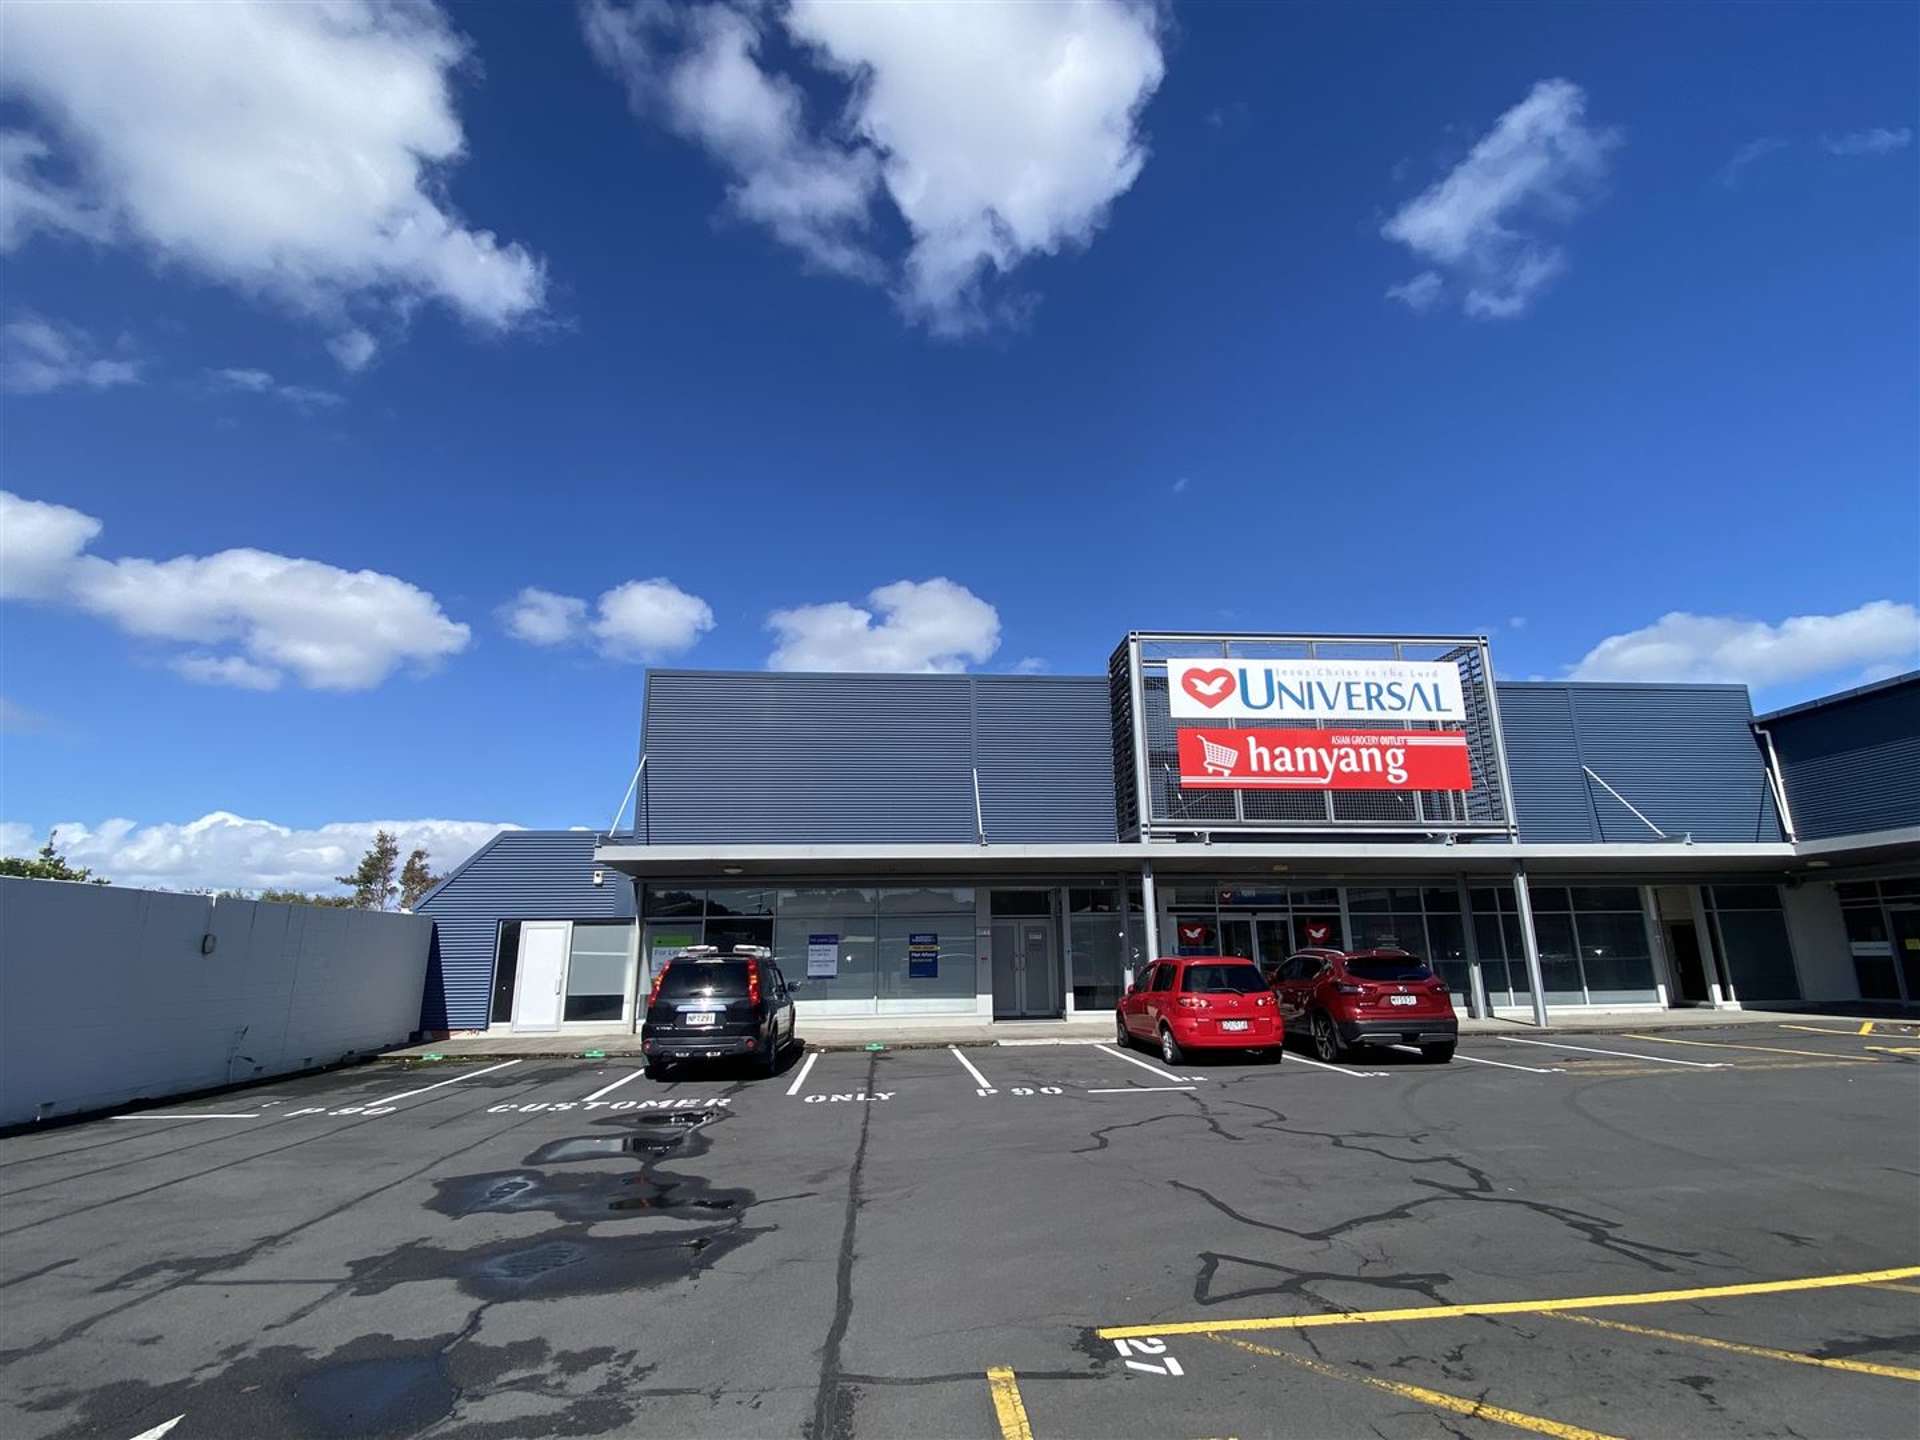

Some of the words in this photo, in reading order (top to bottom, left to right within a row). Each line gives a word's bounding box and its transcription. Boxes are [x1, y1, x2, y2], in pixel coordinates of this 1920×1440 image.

[1238, 668, 1453, 712] UNIVERSAL
[1331, 735, 1351, 745] ASIAN
[1351, 735, 1379, 745] GROCERY
[1379, 735, 1406, 745] OUTLET
[1247, 735, 1409, 784] hanyang
[487, 1098, 732, 1113] CUSTOMER
[803, 1092, 896, 1103] ONLY
[1113, 1336, 1185, 1376] 27
